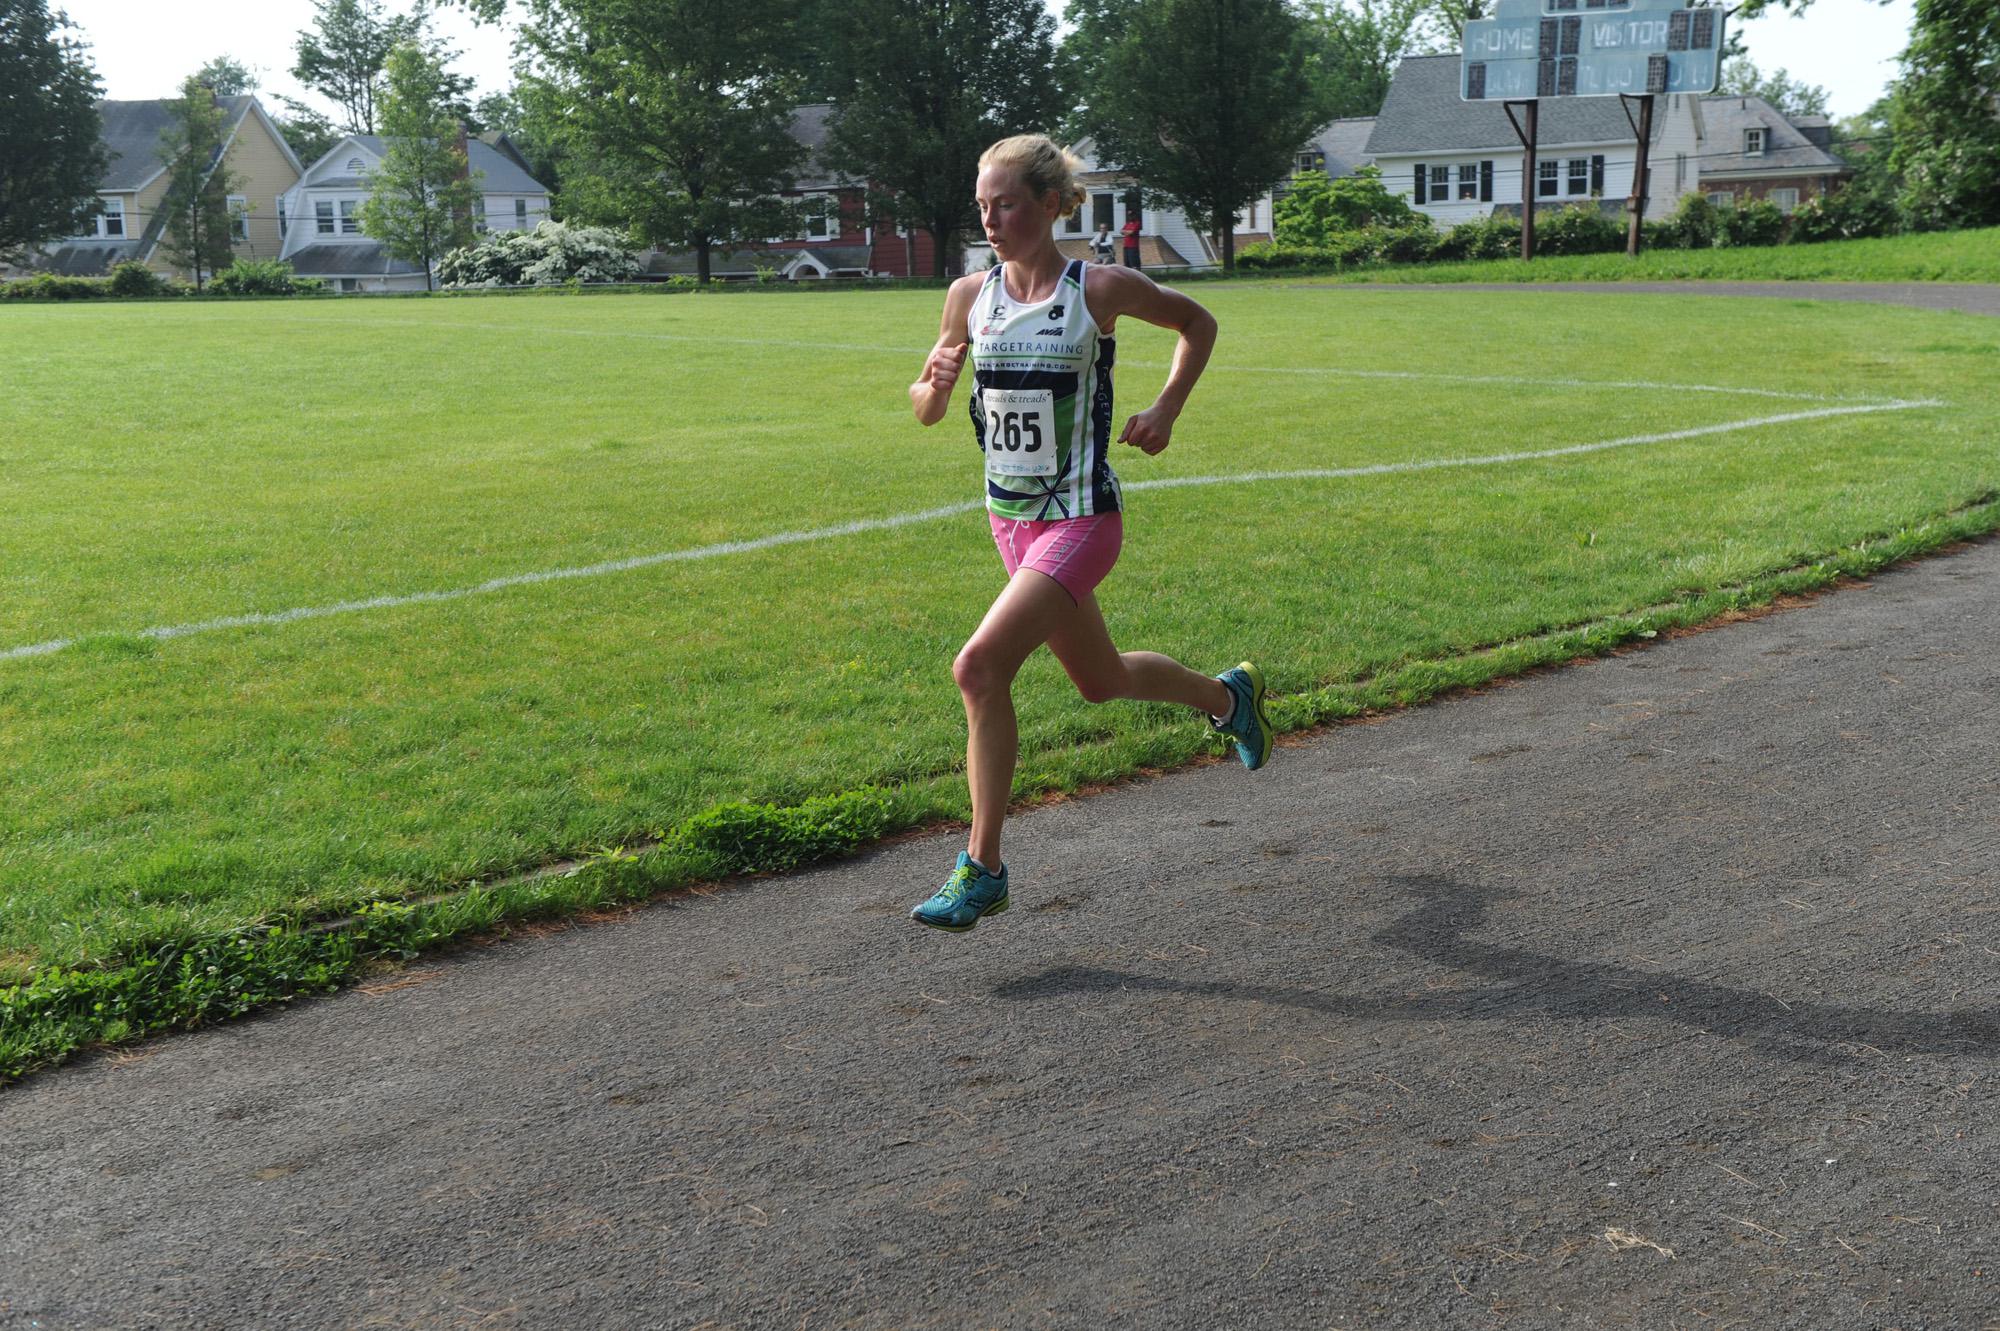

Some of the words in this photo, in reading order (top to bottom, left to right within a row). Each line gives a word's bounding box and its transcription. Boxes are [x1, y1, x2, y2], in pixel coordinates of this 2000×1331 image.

[1472, 27, 1535, 52] HOME
[1592, 19, 1668, 48] VISITOR
[1035, 327, 1066, 337] AVIA
[979, 342, 1084, 355] TARGETRAINING
[1007, 392, 1018, 403] &
[1018, 393, 1047, 404] treads
[990, 410, 1042, 453] 265
